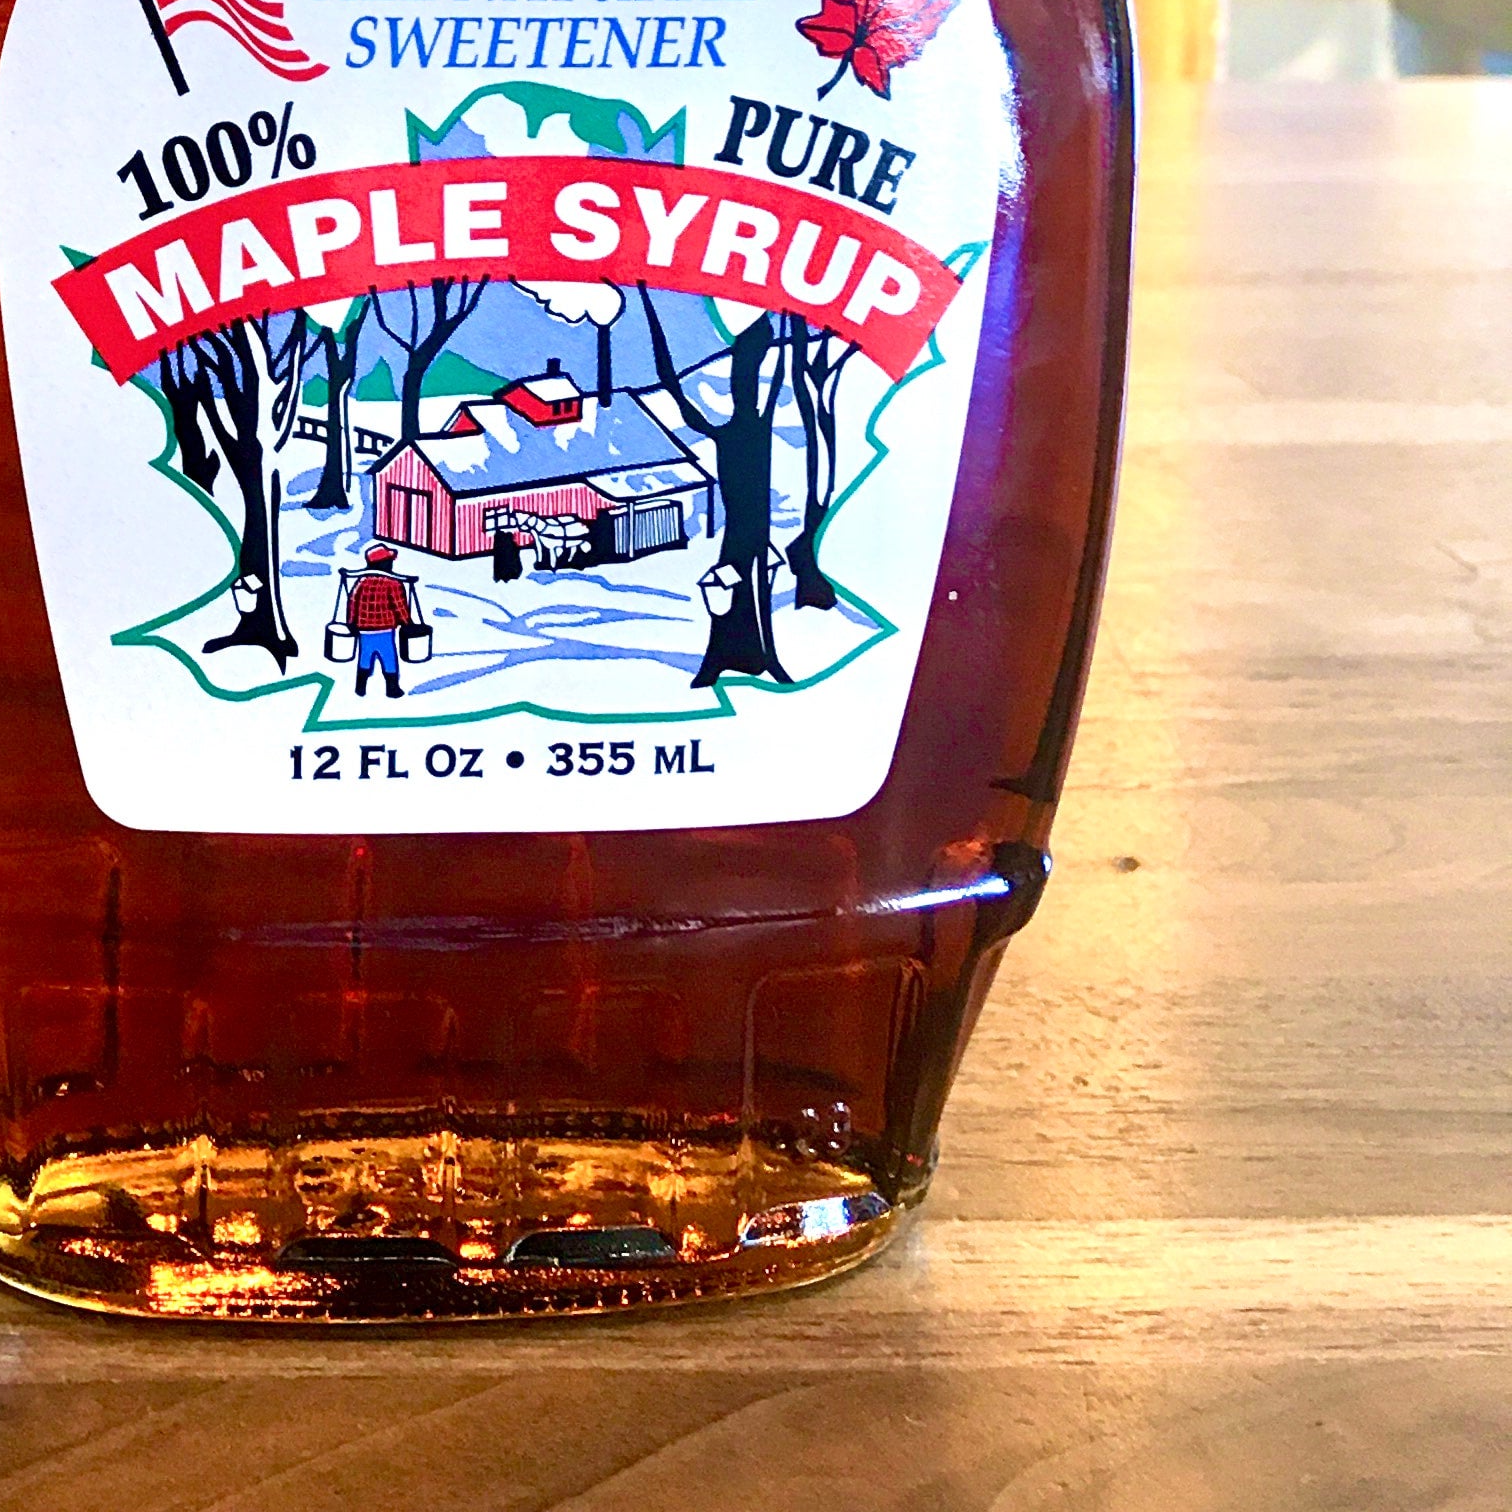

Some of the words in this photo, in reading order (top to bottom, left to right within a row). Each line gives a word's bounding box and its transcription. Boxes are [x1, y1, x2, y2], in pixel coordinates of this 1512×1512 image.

[345, 15, 727, 69] SWEETENER
[116, 100, 317, 221] 100%
[713, 94, 918, 216] PURE
[103, 181, 510, 341] MAPLE
[549, 181, 922, 327] SYRUP
[289, 745, 342, 781] 12
[546, 740, 636, 777] 355
